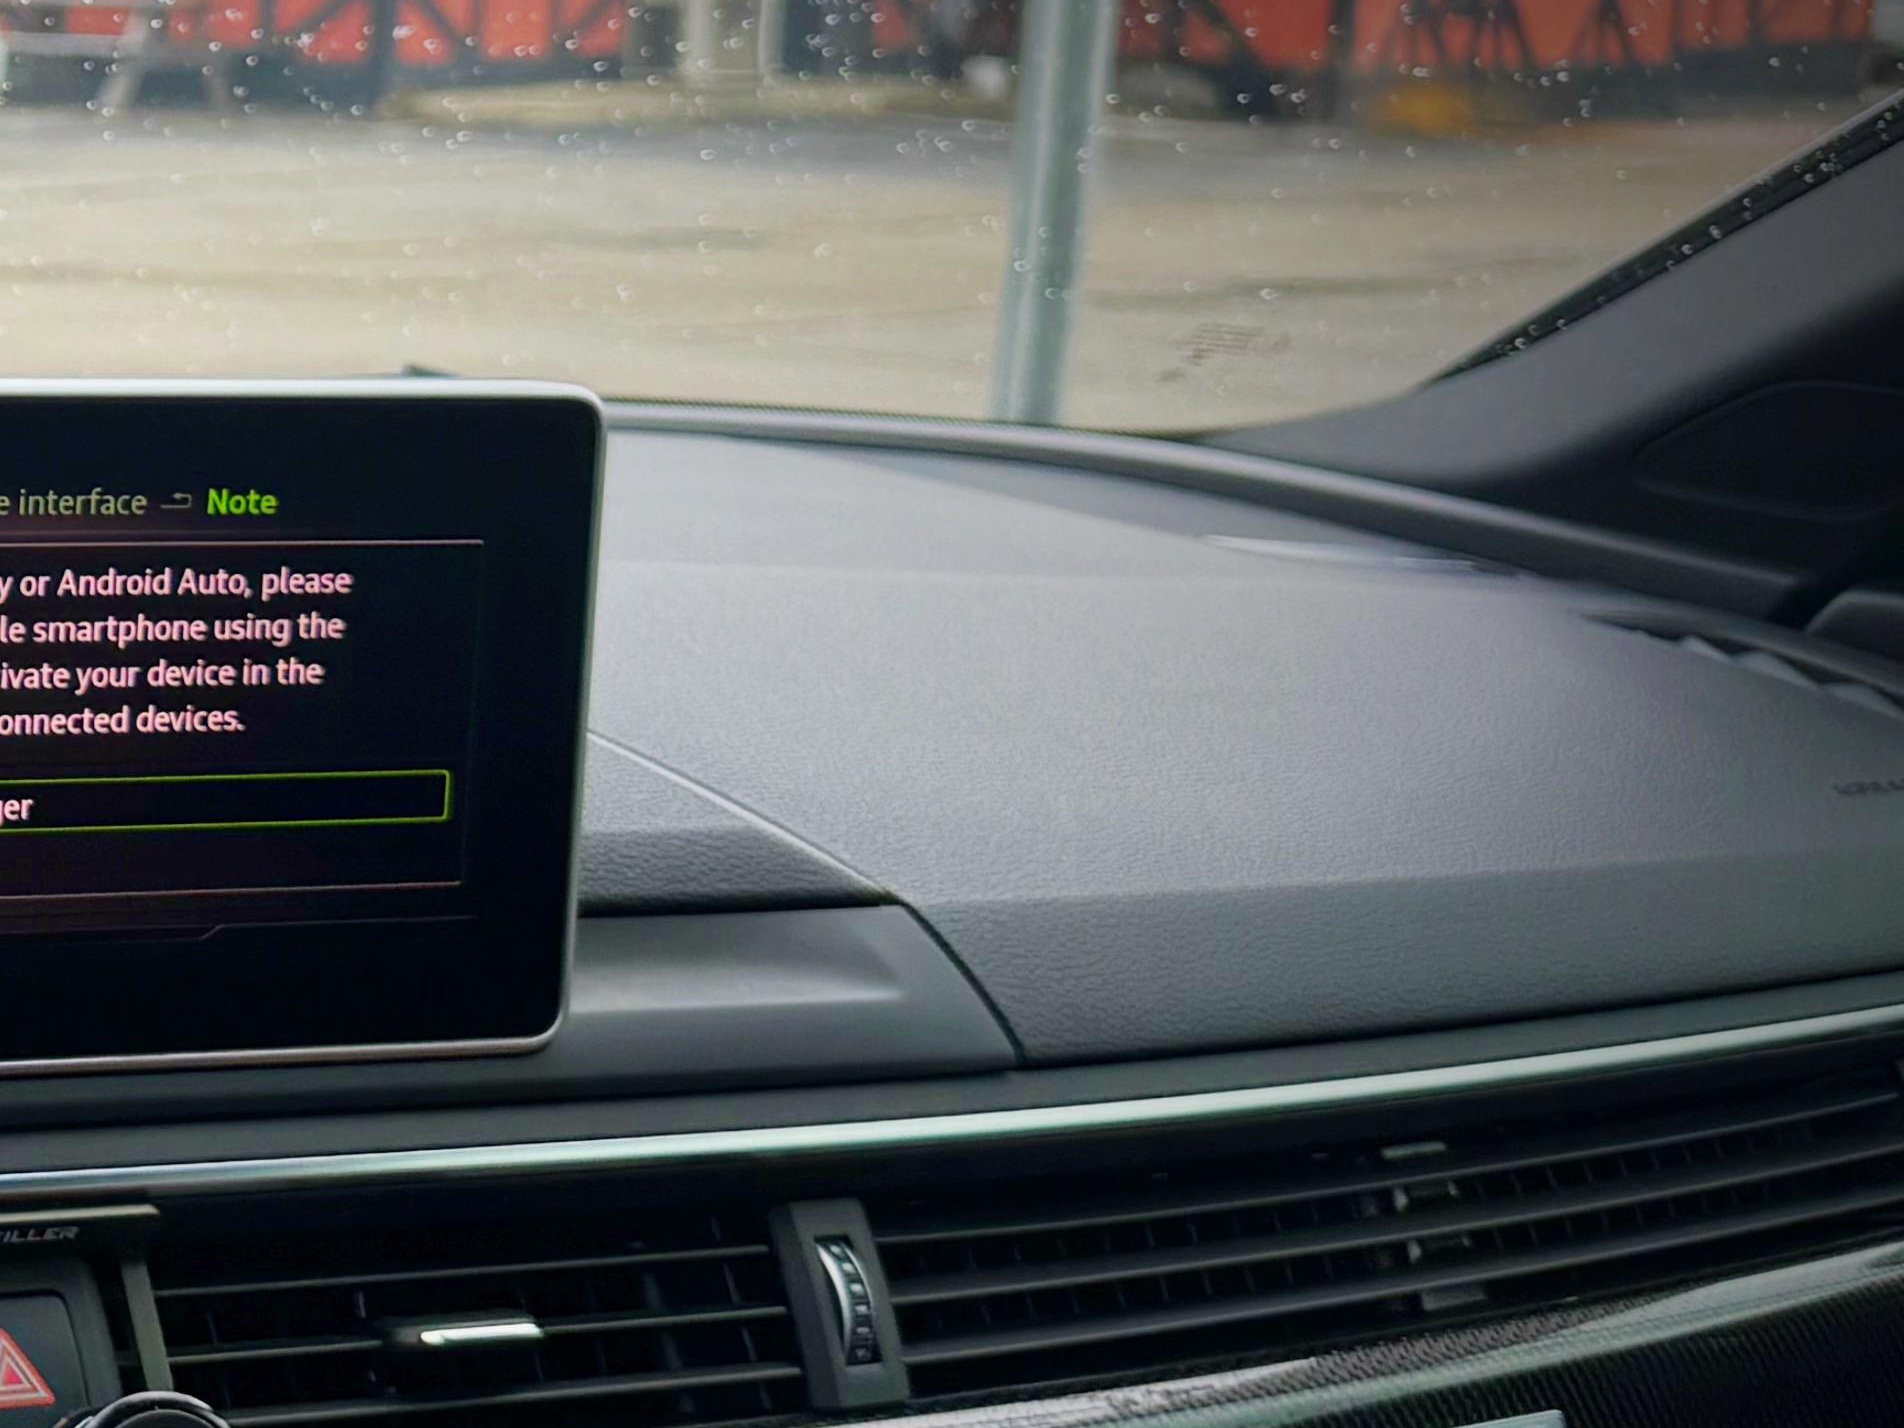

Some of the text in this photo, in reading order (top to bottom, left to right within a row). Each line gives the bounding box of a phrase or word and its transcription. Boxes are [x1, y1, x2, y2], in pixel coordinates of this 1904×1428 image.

[18, 487, 148, 516] interface
[207, 488, 278, 515] Note
[19, 575, 51, 597] or
[56, 566, 172, 597] Android
[177, 568, 252, 599] Auto,
[261, 566, 353, 602] please
[32, 613, 209, 649] smartphone
[213, 612, 292, 648] using
[296, 611, 346, 639] the
[74, 666, 141, 696] your
[146, 658, 237, 687] device
[242, 658, 270, 686] in
[275, 656, 325, 685] the
[135, 704, 245, 733] devices.
